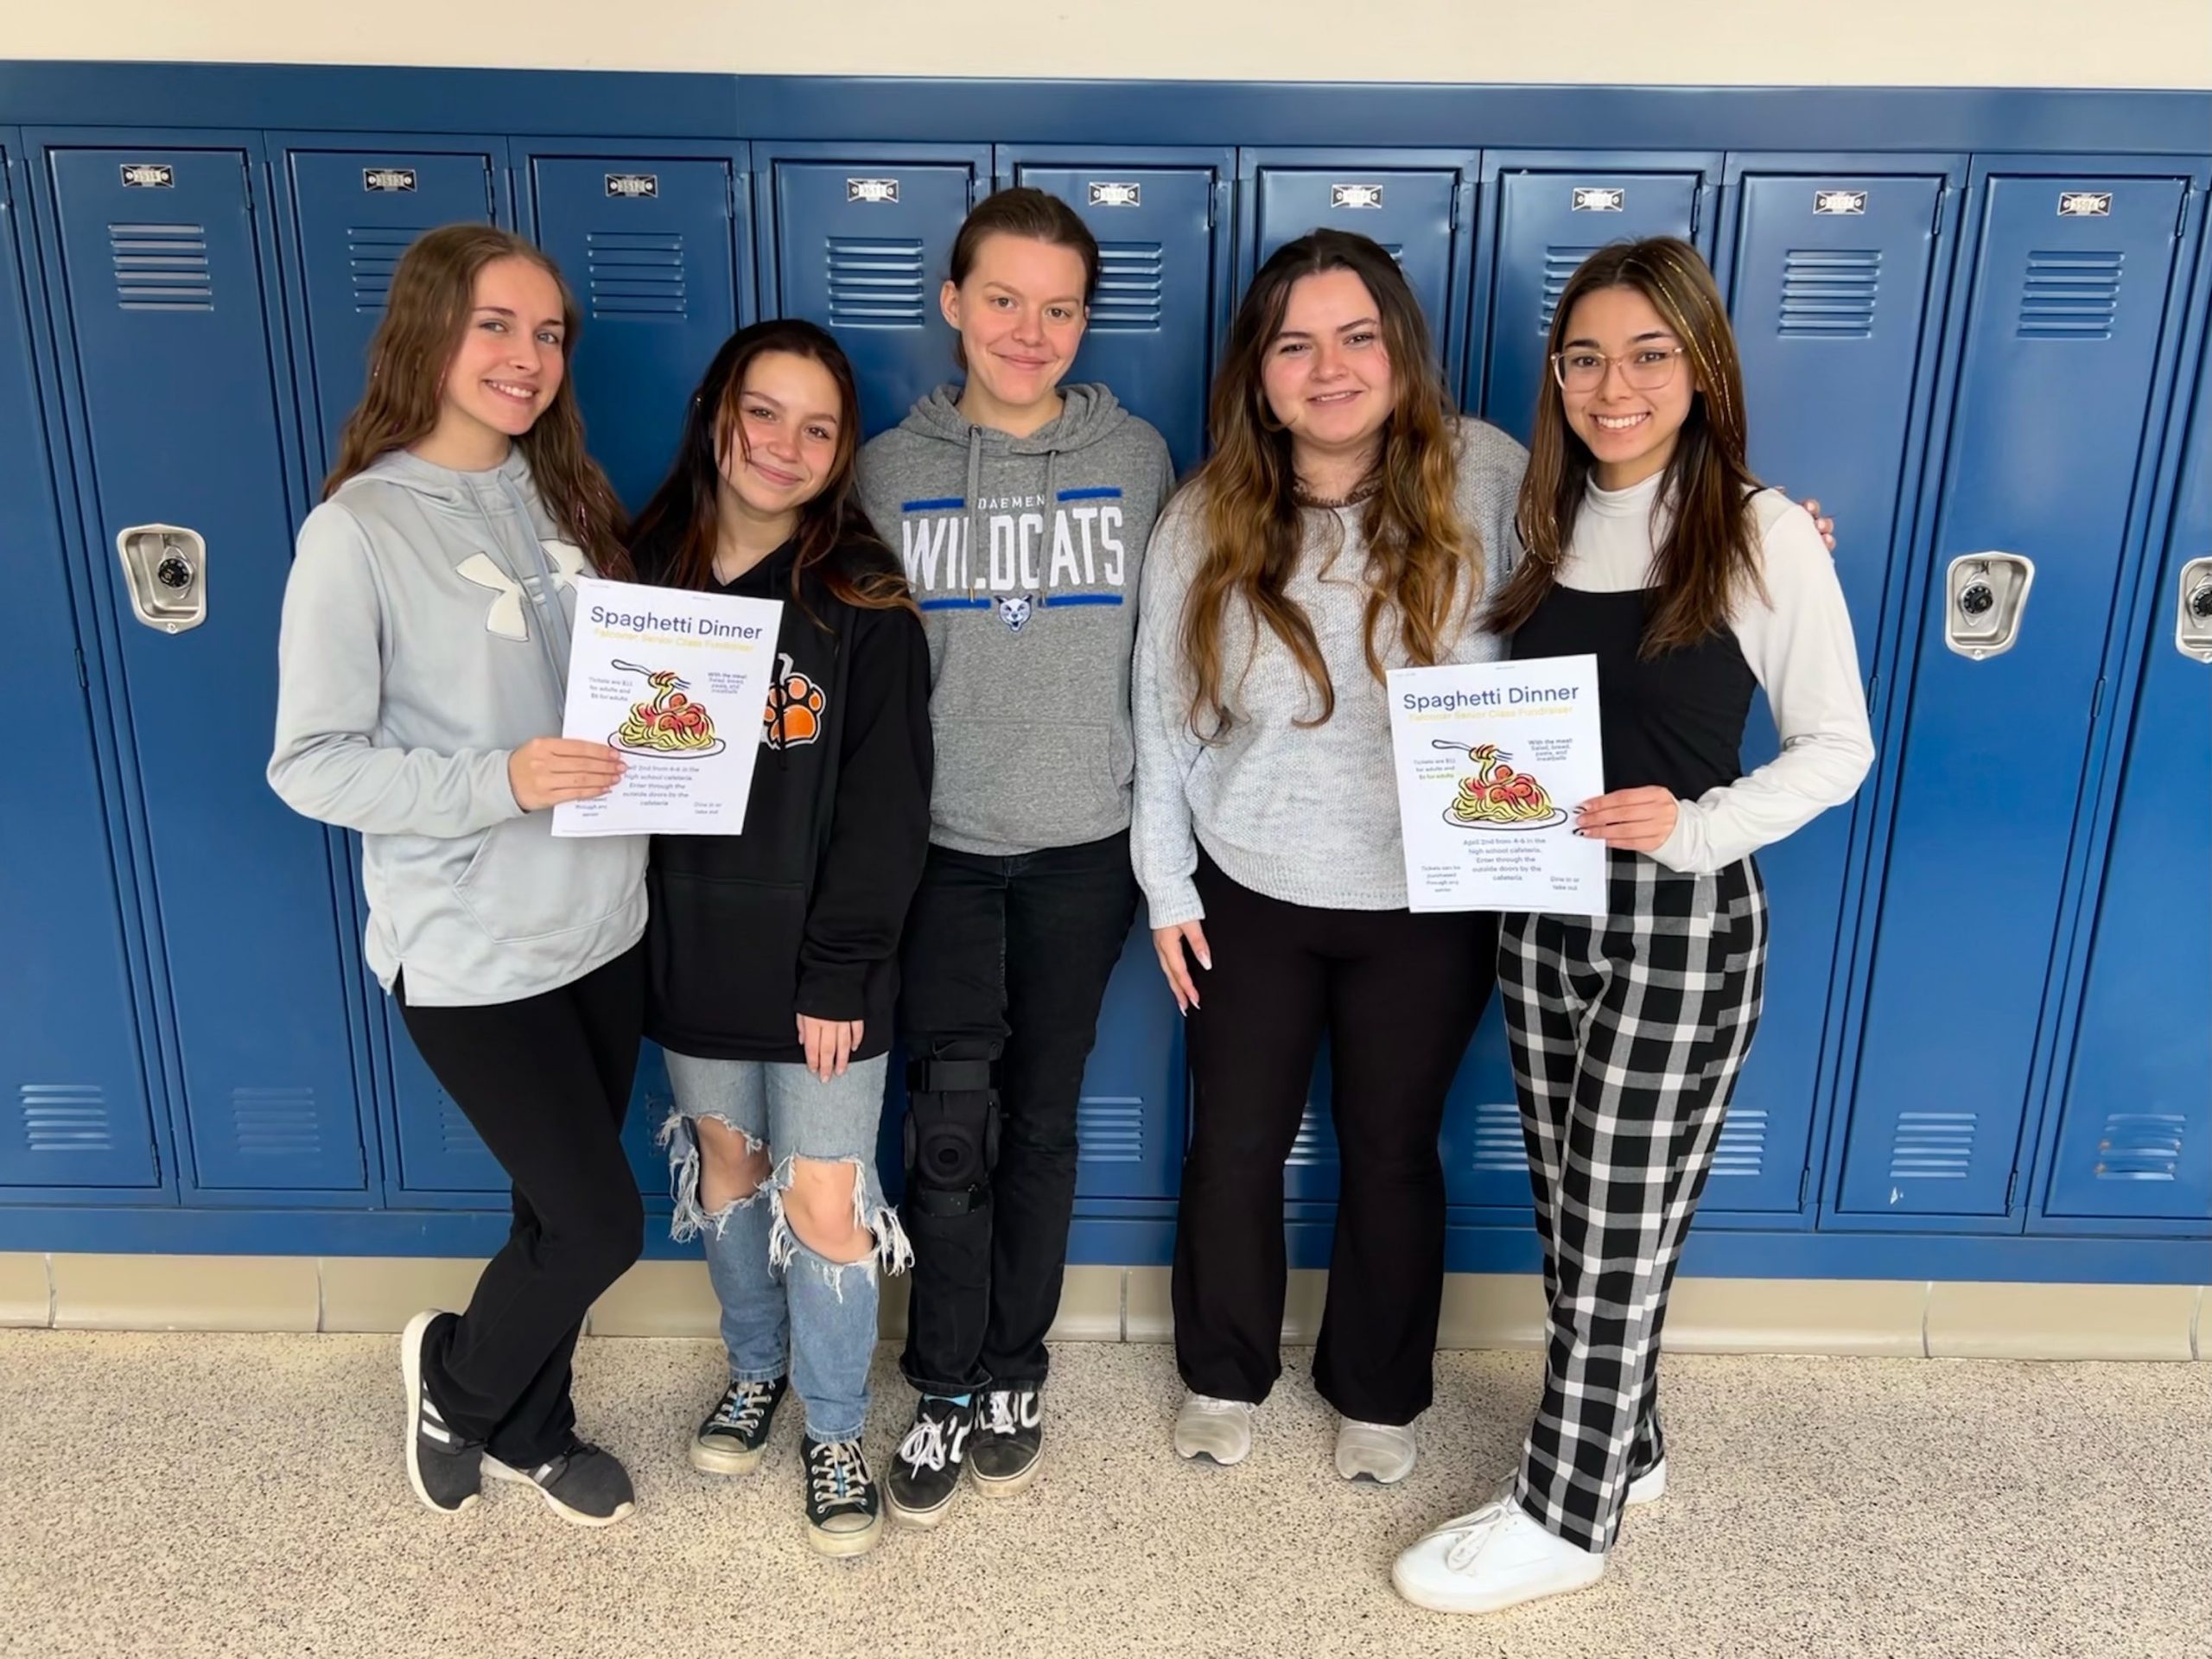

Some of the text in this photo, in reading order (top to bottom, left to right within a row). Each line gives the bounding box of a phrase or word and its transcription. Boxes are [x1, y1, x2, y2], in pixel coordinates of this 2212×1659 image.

[977, 494, 1047, 510] DAEMEN
[902, 505, 1124, 594] WILDCATS
[590, 606, 763, 639] Spaghetti Dinner
[1403, 686, 1580, 713] Spaghetti Dinner
